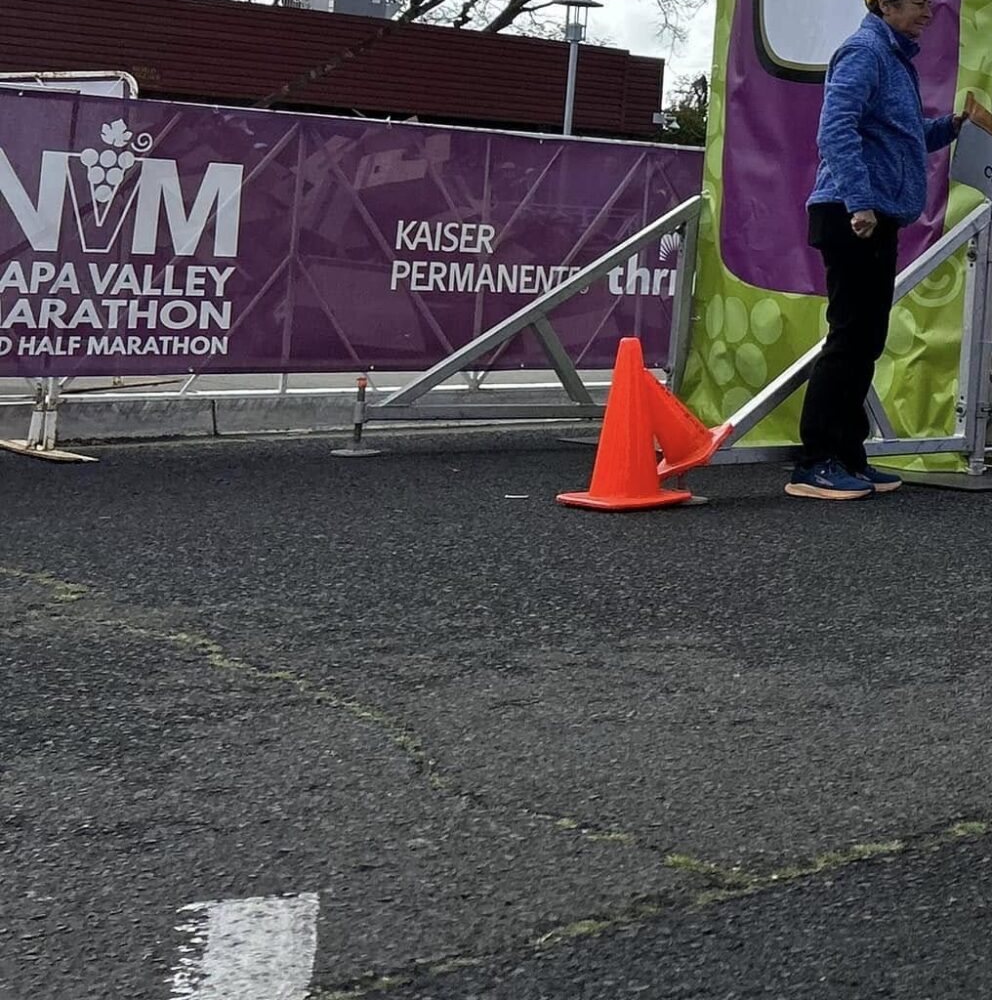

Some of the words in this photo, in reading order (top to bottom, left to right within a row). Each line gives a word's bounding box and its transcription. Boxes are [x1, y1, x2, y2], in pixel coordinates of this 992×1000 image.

[396, 220, 496, 254] KAISER
[0, 261, 80, 294] APA
[88, 263, 236, 296] VALLEY
[0, 299, 231, 330] ARATHON
[17, 336, 81, 356] HALF
[87, 336, 228, 356] MARATHON
